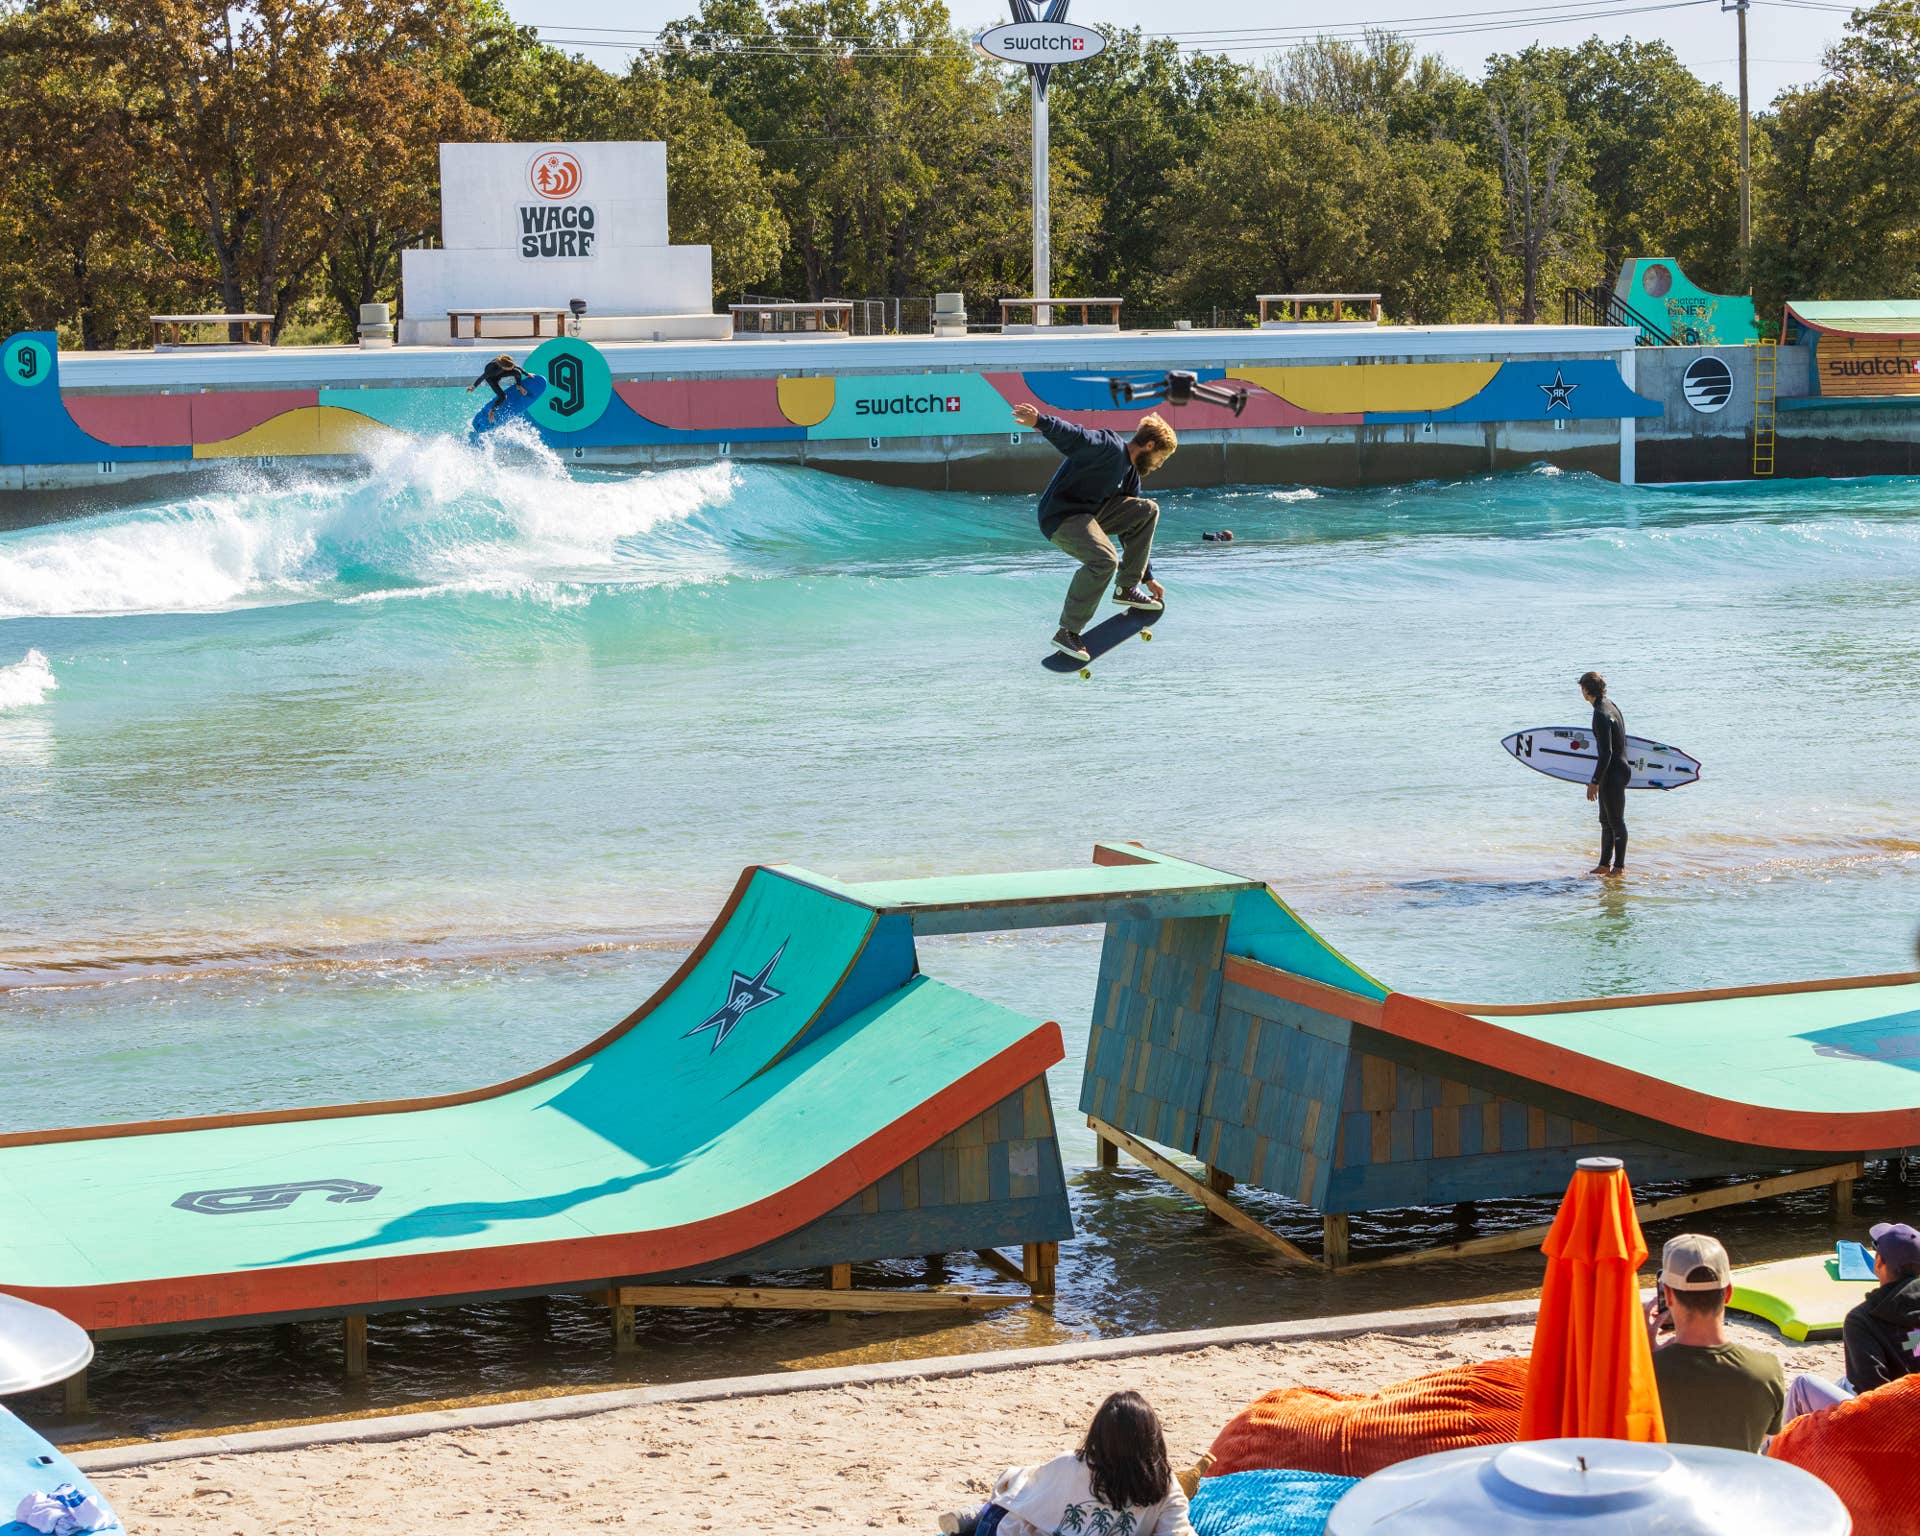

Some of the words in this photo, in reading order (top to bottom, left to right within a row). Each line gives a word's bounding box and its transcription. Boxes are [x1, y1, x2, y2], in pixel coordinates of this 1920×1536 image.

[1003, 35, 1071, 50] swatch
[520, 206, 594, 234] WACO
[522, 230, 595, 257] SURF
[1667, 297, 1702, 305] satch
[17, 346, 37, 379] 9
[1829, 357, 1911, 376] swatch
[548, 352, 585, 417] 9
[855, 394, 944, 415] swatch
[871, 437, 878, 447] 6
[1012, 432, 1020, 443] 5
